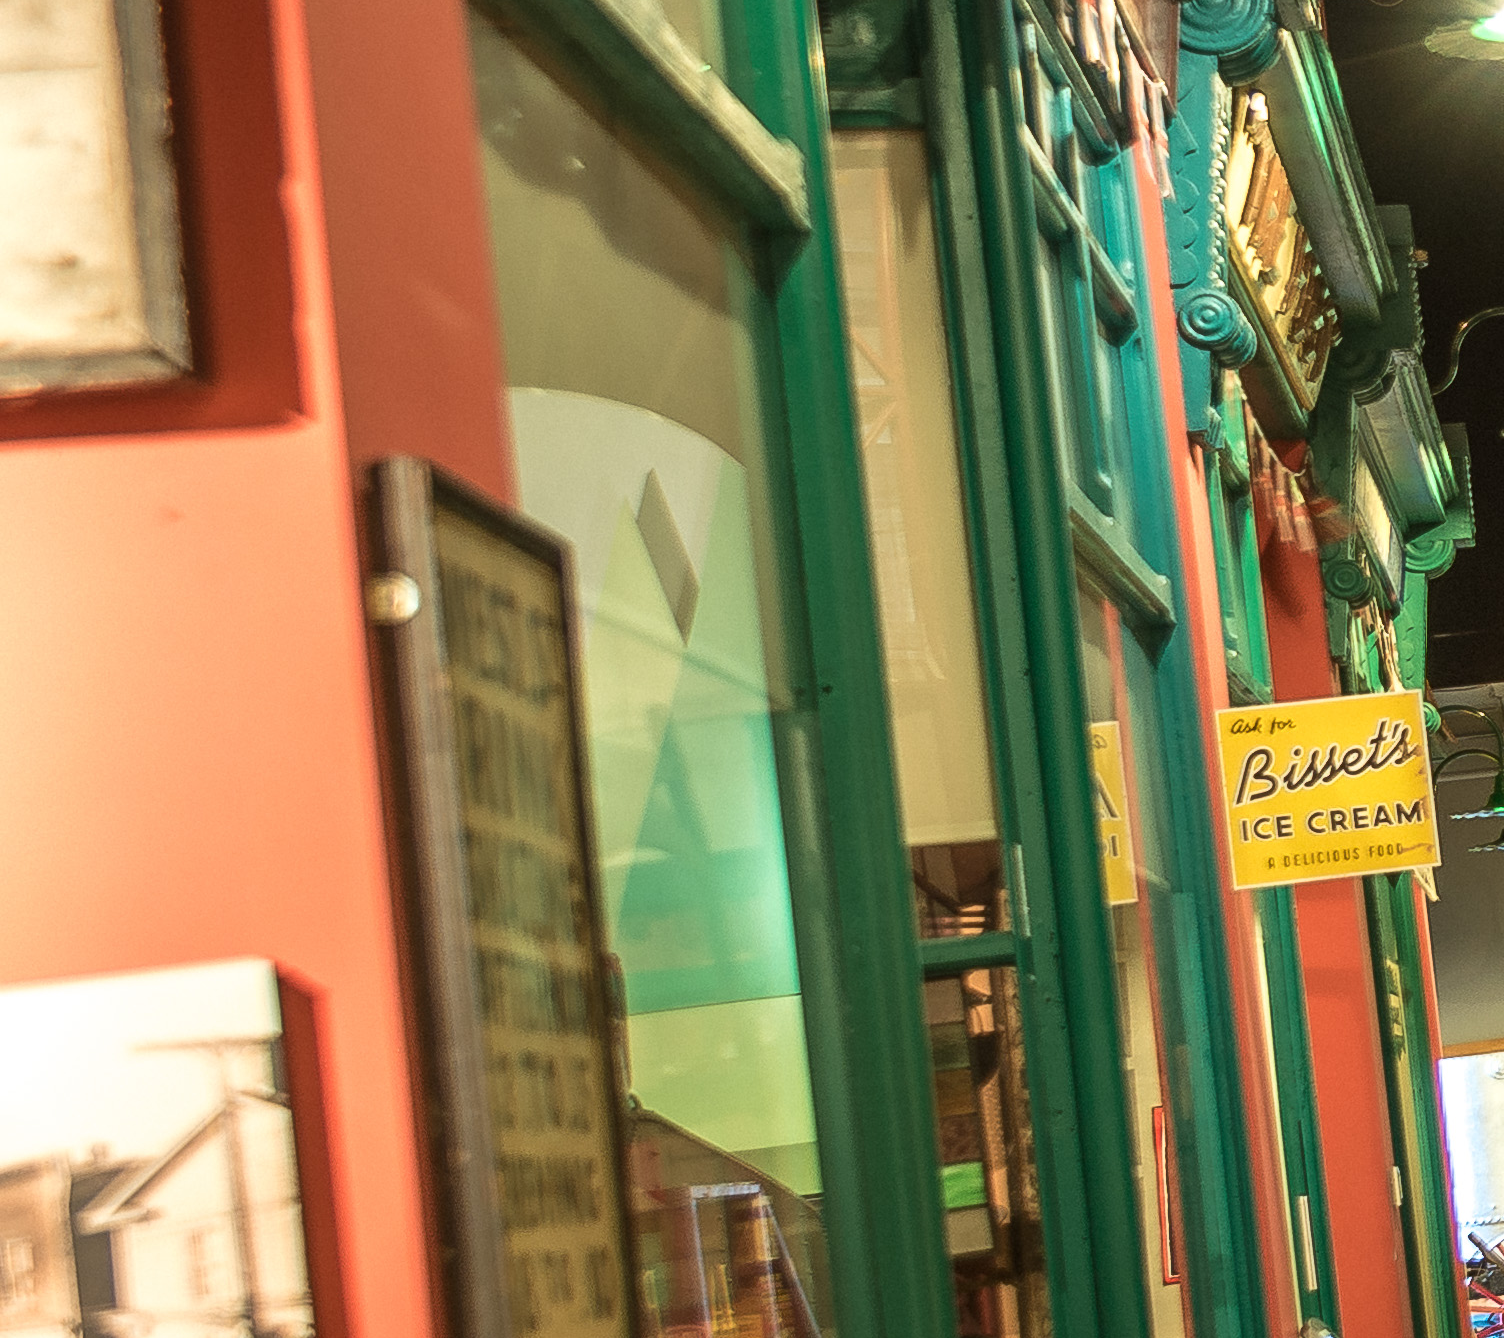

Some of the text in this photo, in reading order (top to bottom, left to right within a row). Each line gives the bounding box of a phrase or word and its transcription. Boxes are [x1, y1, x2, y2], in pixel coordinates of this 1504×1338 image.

[1269, 717, 1297, 735] for
[1234, 718, 1418, 807] Bisset's
[1240, 799, 1424, 842] ICE CREAM
[1267, 843, 1404, 869] A DELICIOUS FOOD
